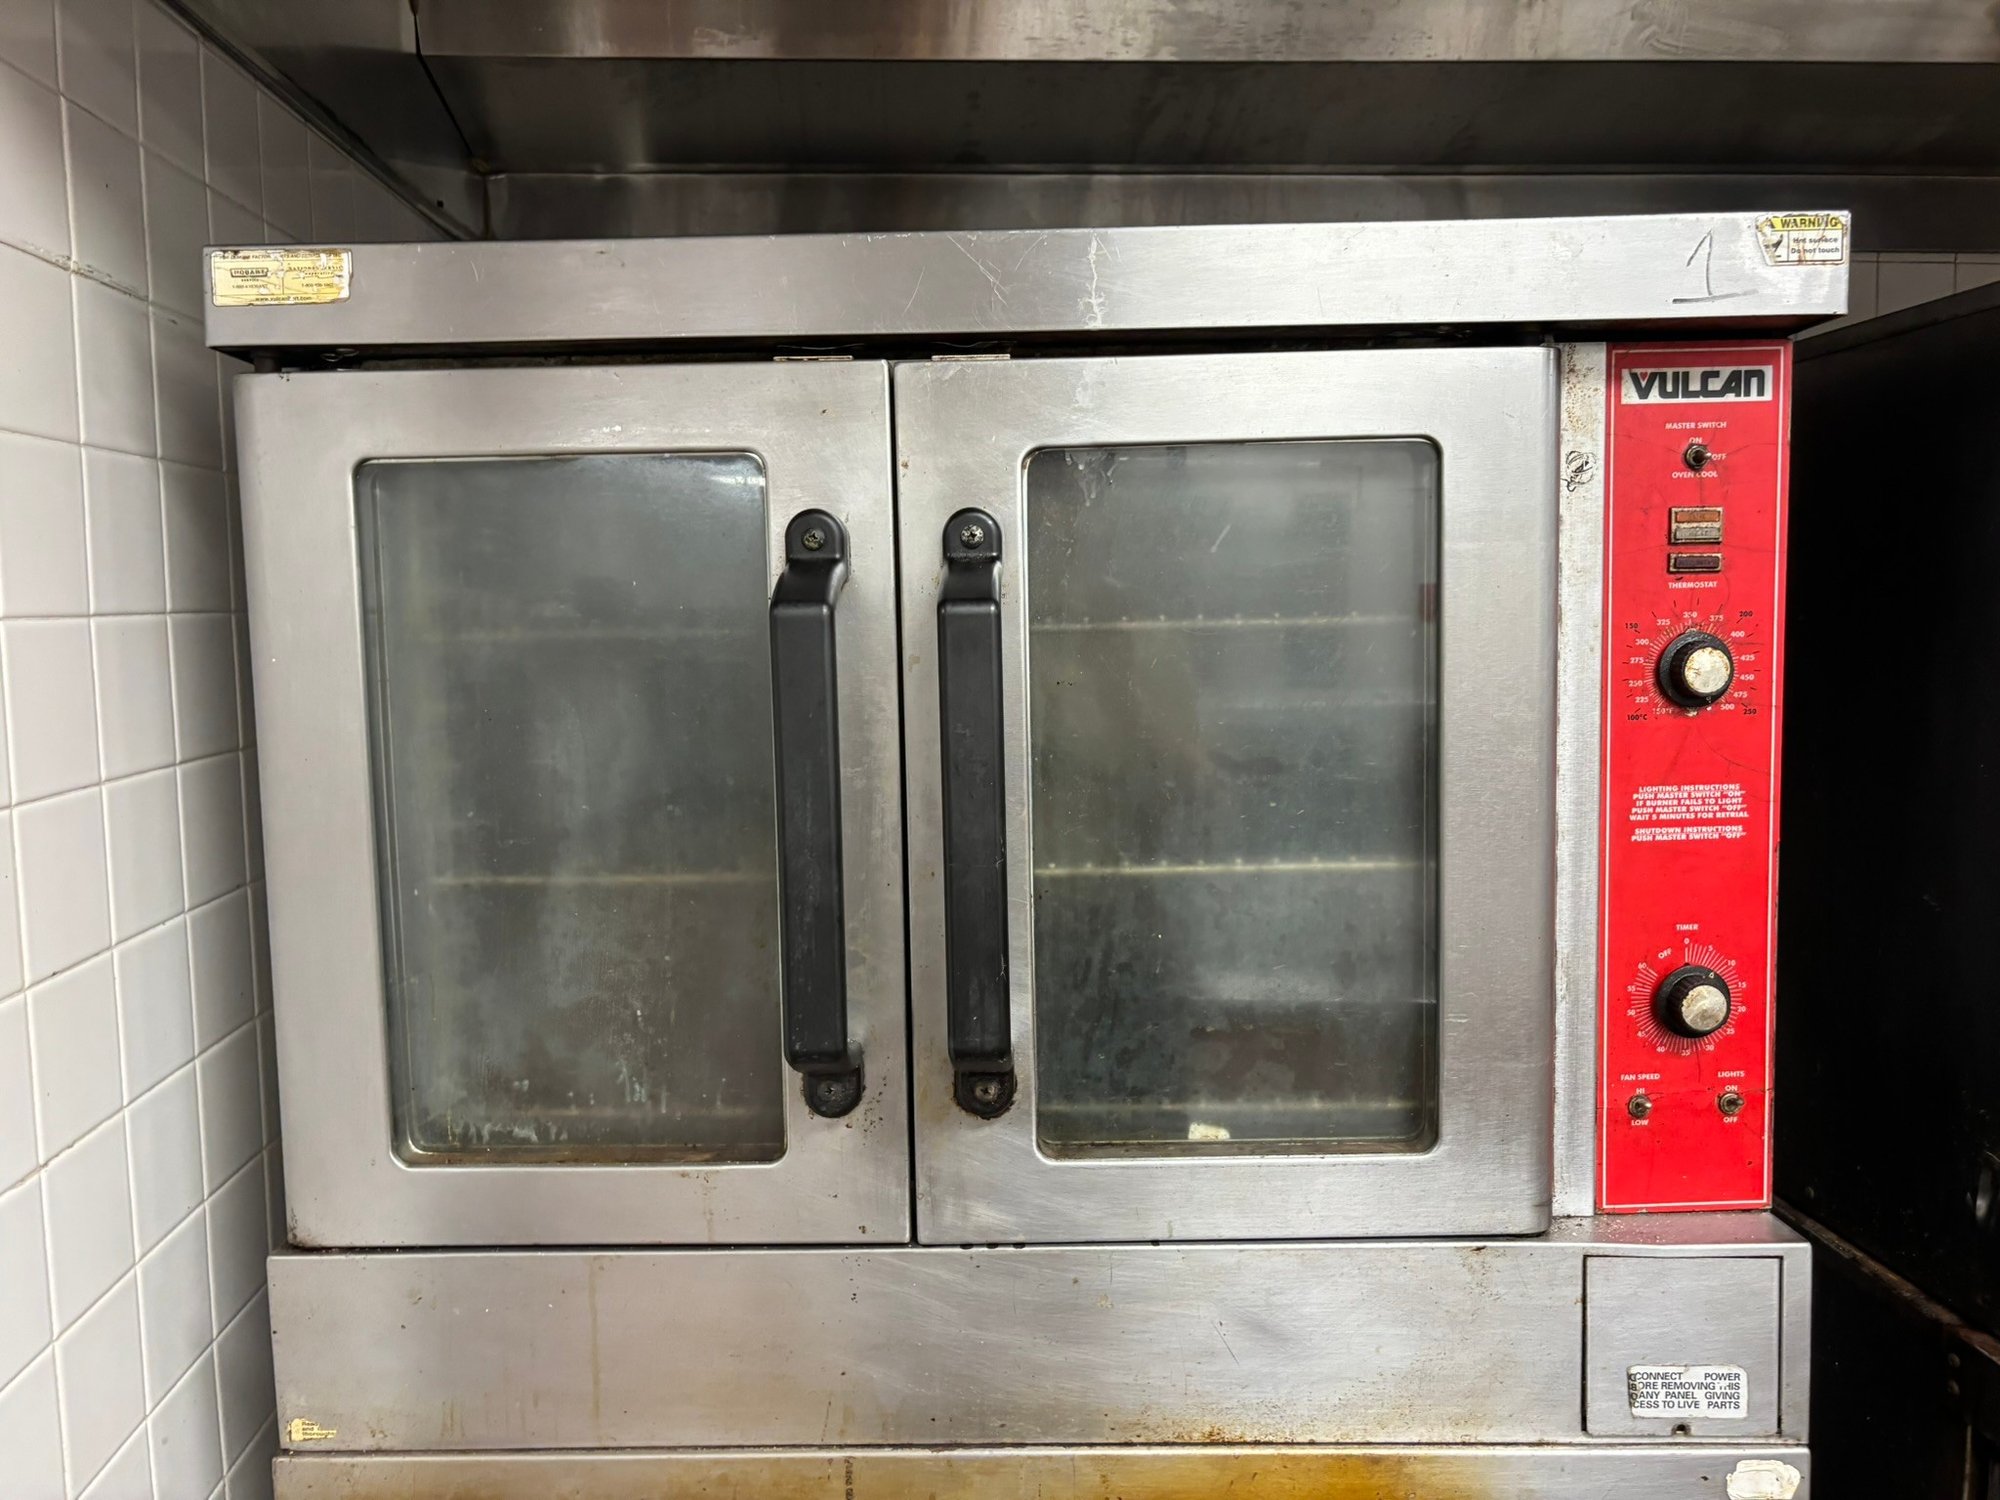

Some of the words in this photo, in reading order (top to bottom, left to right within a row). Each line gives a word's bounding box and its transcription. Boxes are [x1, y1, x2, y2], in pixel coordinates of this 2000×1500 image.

[1630, 369, 1765, 400] VULCAN
[1696, 470, 1718, 478] COOL
[1668, 581, 1718, 589] THERMOSTAT
[1656, 618, 1671, 626] 325
[1731, 630, 1745, 638] 400
[1630, 656, 1644, 664] 275
[1740, 673, 1755, 681] 450
[1659, 812, 1695, 820] MINUTES
[1697, 811, 1714, 819] FOR
[1716, 810, 1749, 818] RETRIAL
[1635, 827, 1681, 835] SHUTDOWN
[1683, 825, 1743, 833] INSTRUCTIONS
[1658, 947, 1672, 960] OFF
[1638, 962, 1647, 970] 60
[1727, 959, 1736, 967] 10
[1737, 1005, 1747, 1013] 20
[1726, 1027, 1735, 1035] 25
[1620, 1073, 1636, 1081] FAN
[1717, 1070, 1745, 1078] LIGHTS
[1635, 1087, 1645, 1095] HI
[1724, 1084, 1738, 1092] ON
[1704, 1372, 1741, 1381] POWER
[1661, 1381, 1716, 1391] REMOVING
[1665, 1391, 1698, 1400] PANEL
[1704, 1391, 1740, 1400] GIVING
[1662, 1400, 1675, 1409] TO
[1678, 1400, 1700, 1409] LIVE
[1707, 1401, 1740, 1409] PARTS
